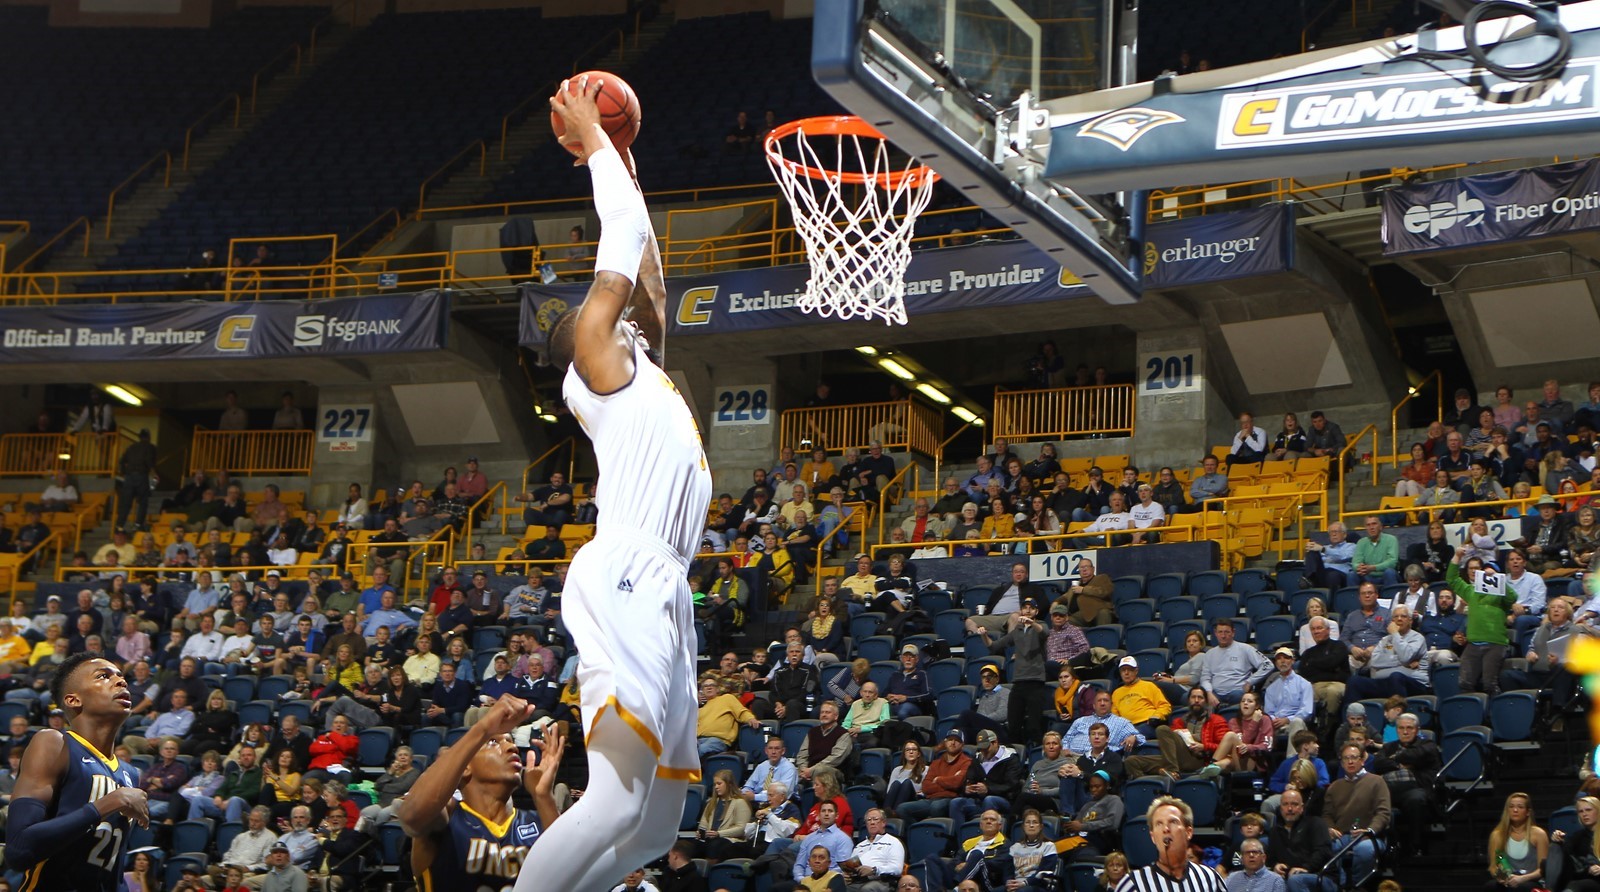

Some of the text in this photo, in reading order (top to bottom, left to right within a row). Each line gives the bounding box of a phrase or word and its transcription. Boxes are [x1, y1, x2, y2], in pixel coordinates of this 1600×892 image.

[1404, 190, 1600, 239] epb Fiber Opti
[1162, 238, 1260, 263] erlanger
[728, 288, 813, 313] Exclusi
[949, 264, 1044, 291] Provider
[4, 328, 72, 347] Official
[75, 327, 125, 346] Bank
[130, 326, 206, 345] Partner
[327, 317, 401, 341] fsgBANK
[1146, 354, 1193, 390] 201
[718, 389, 767, 421] 228
[323, 408, 370, 437] 227
[1455, 523, 1506, 546] 12
[1042, 553, 1084, 577] 102
[87, 821, 123, 872] 21
